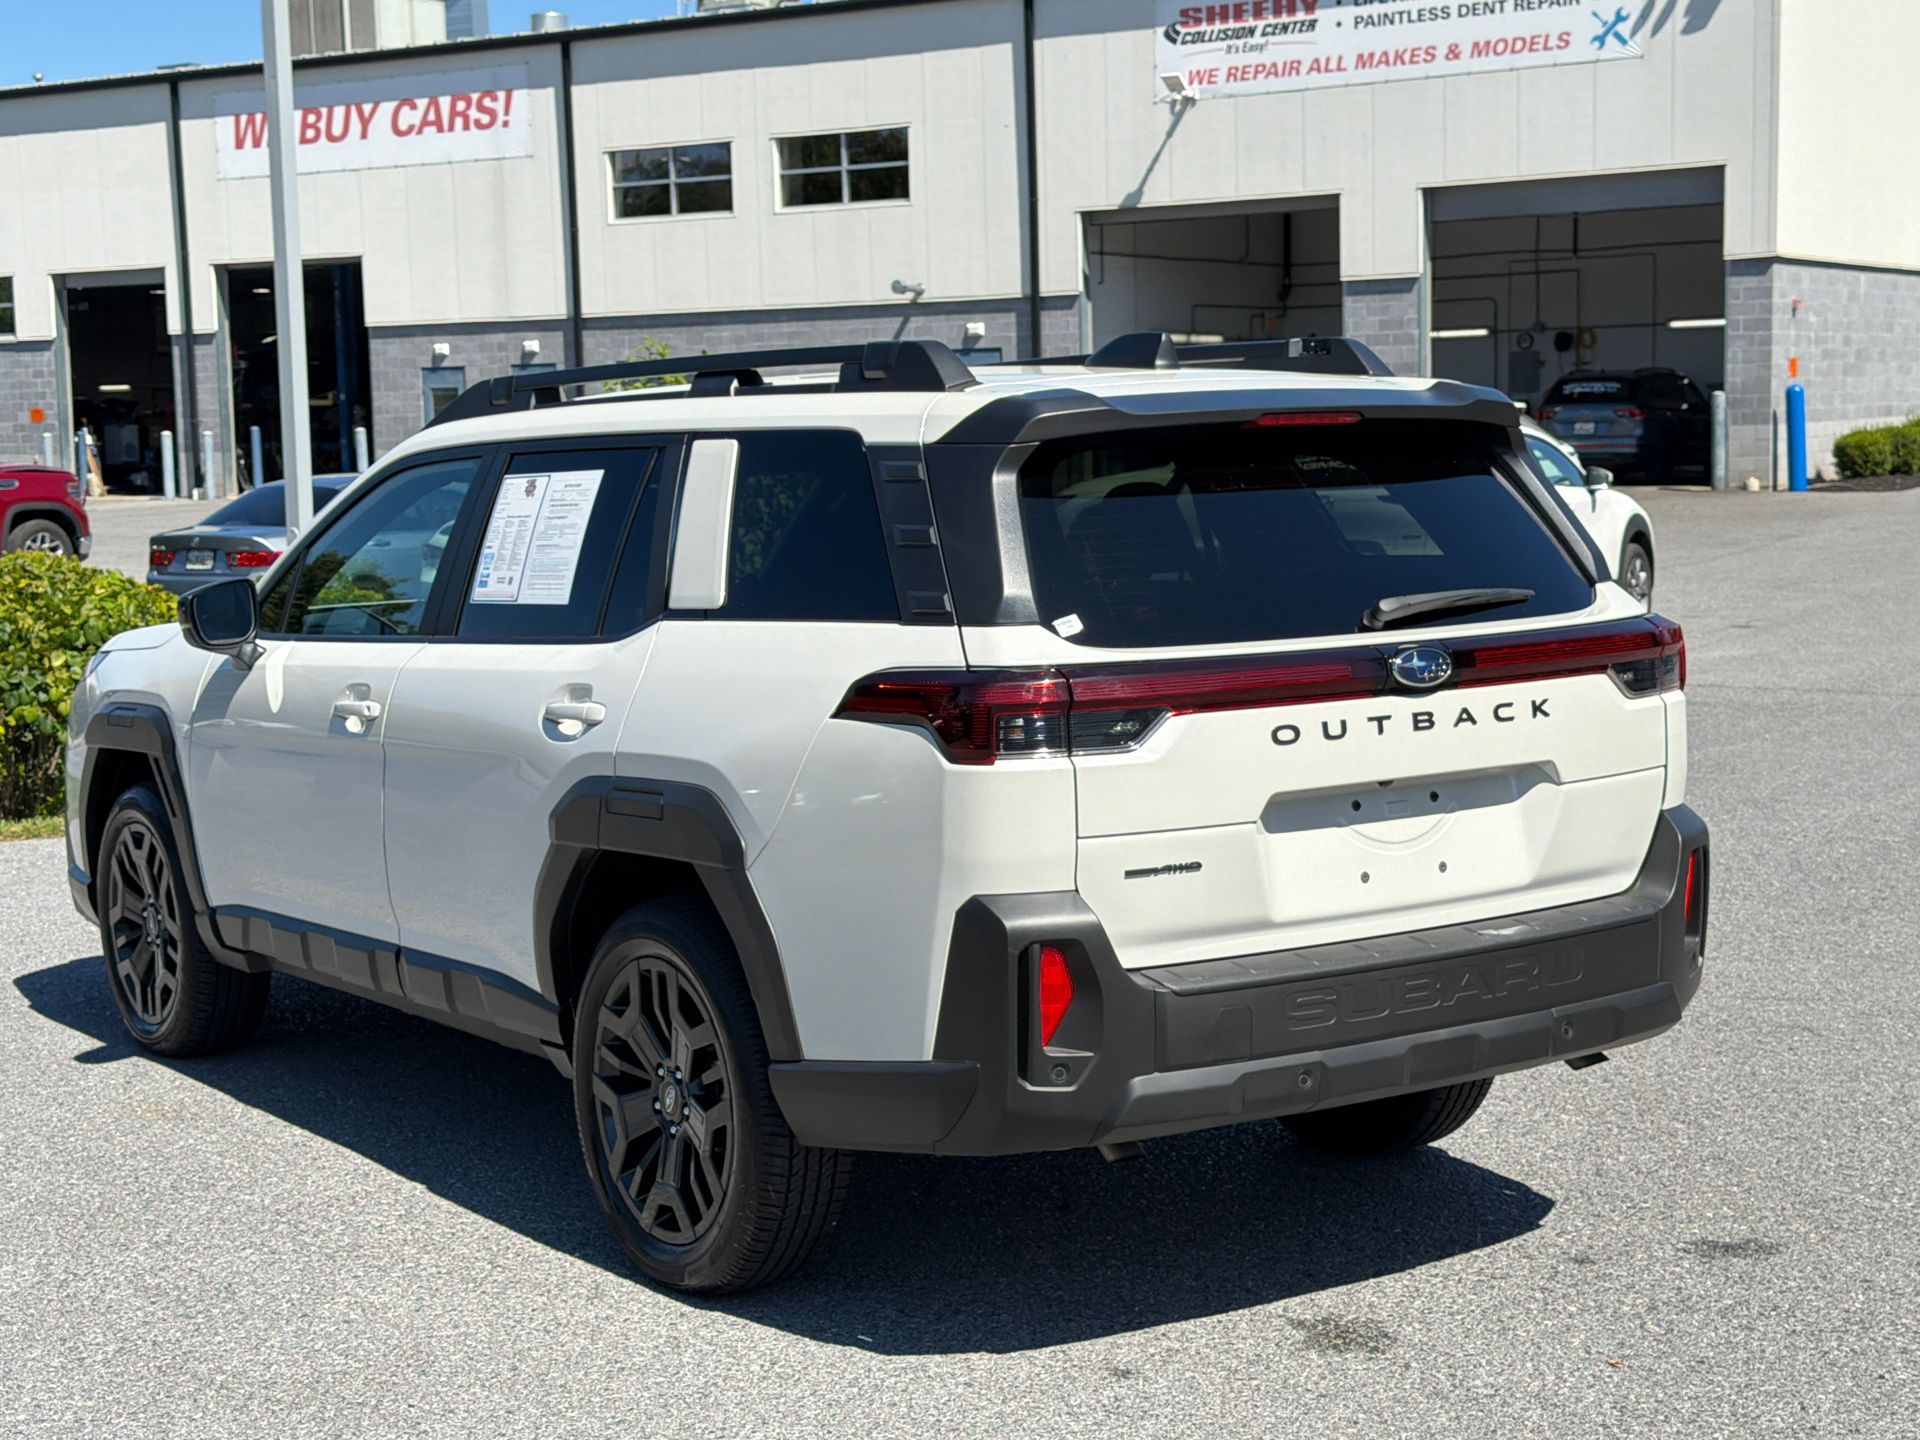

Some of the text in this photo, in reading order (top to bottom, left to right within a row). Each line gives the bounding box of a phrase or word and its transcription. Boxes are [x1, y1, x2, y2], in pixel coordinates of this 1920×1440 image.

[1180, 19, 1319, 45] COLLISION CENTER
[1353, 6, 1451, 30] PAINTLESS
[1457, 0, 1507, 19] DENT
[1188, 31, 1571, 86] WE REPAIR ALL MAKES & MODELS
[234, 89, 513, 150] W BUY CARS!
[1271, 698, 1551, 746] OUTBACK
[1285, 948, 1584, 1031] SUBARU
